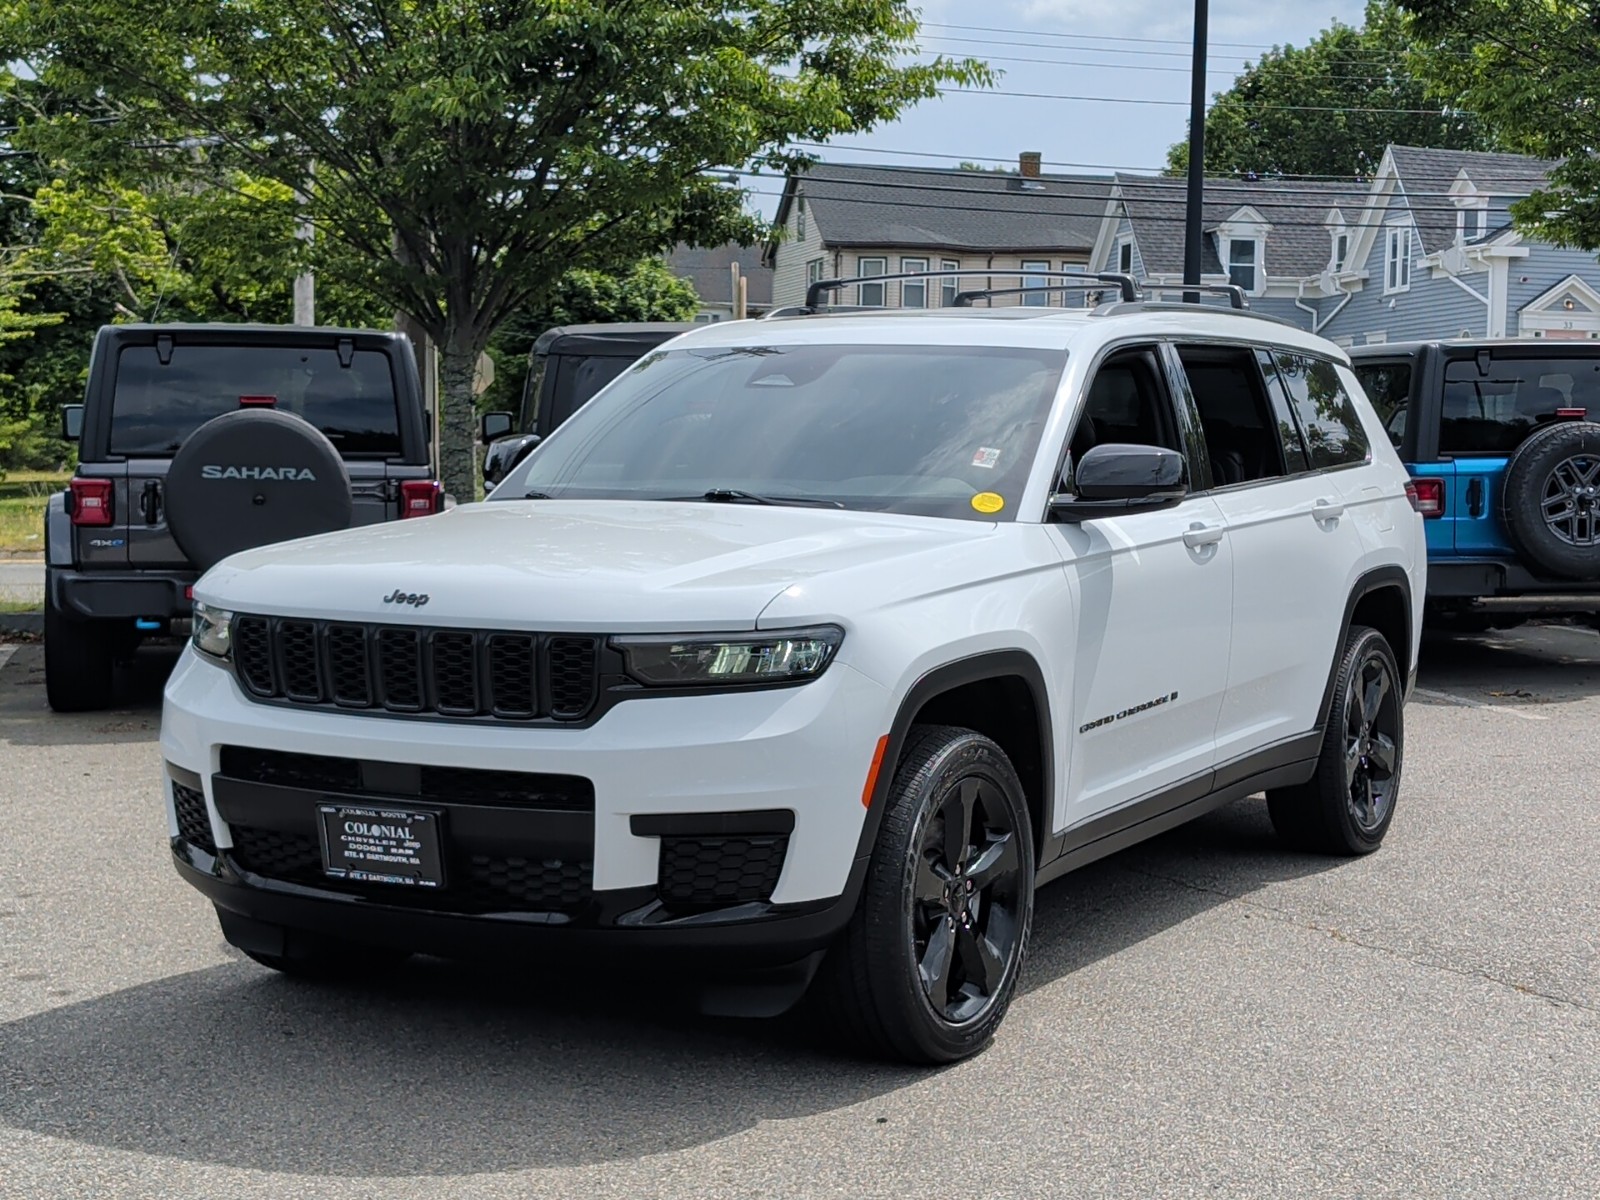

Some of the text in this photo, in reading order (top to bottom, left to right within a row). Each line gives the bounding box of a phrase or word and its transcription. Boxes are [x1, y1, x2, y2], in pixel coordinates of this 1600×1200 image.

[201, 465, 316, 481] SAHARA
[383, 589, 430, 608] Jeep
[341, 808, 378, 817] COLONIAL
[344, 821, 414, 839] COLONIAL
[341, 835, 421, 849] CHRYSLER Jeep
[349, 843, 384, 852] DODGE
